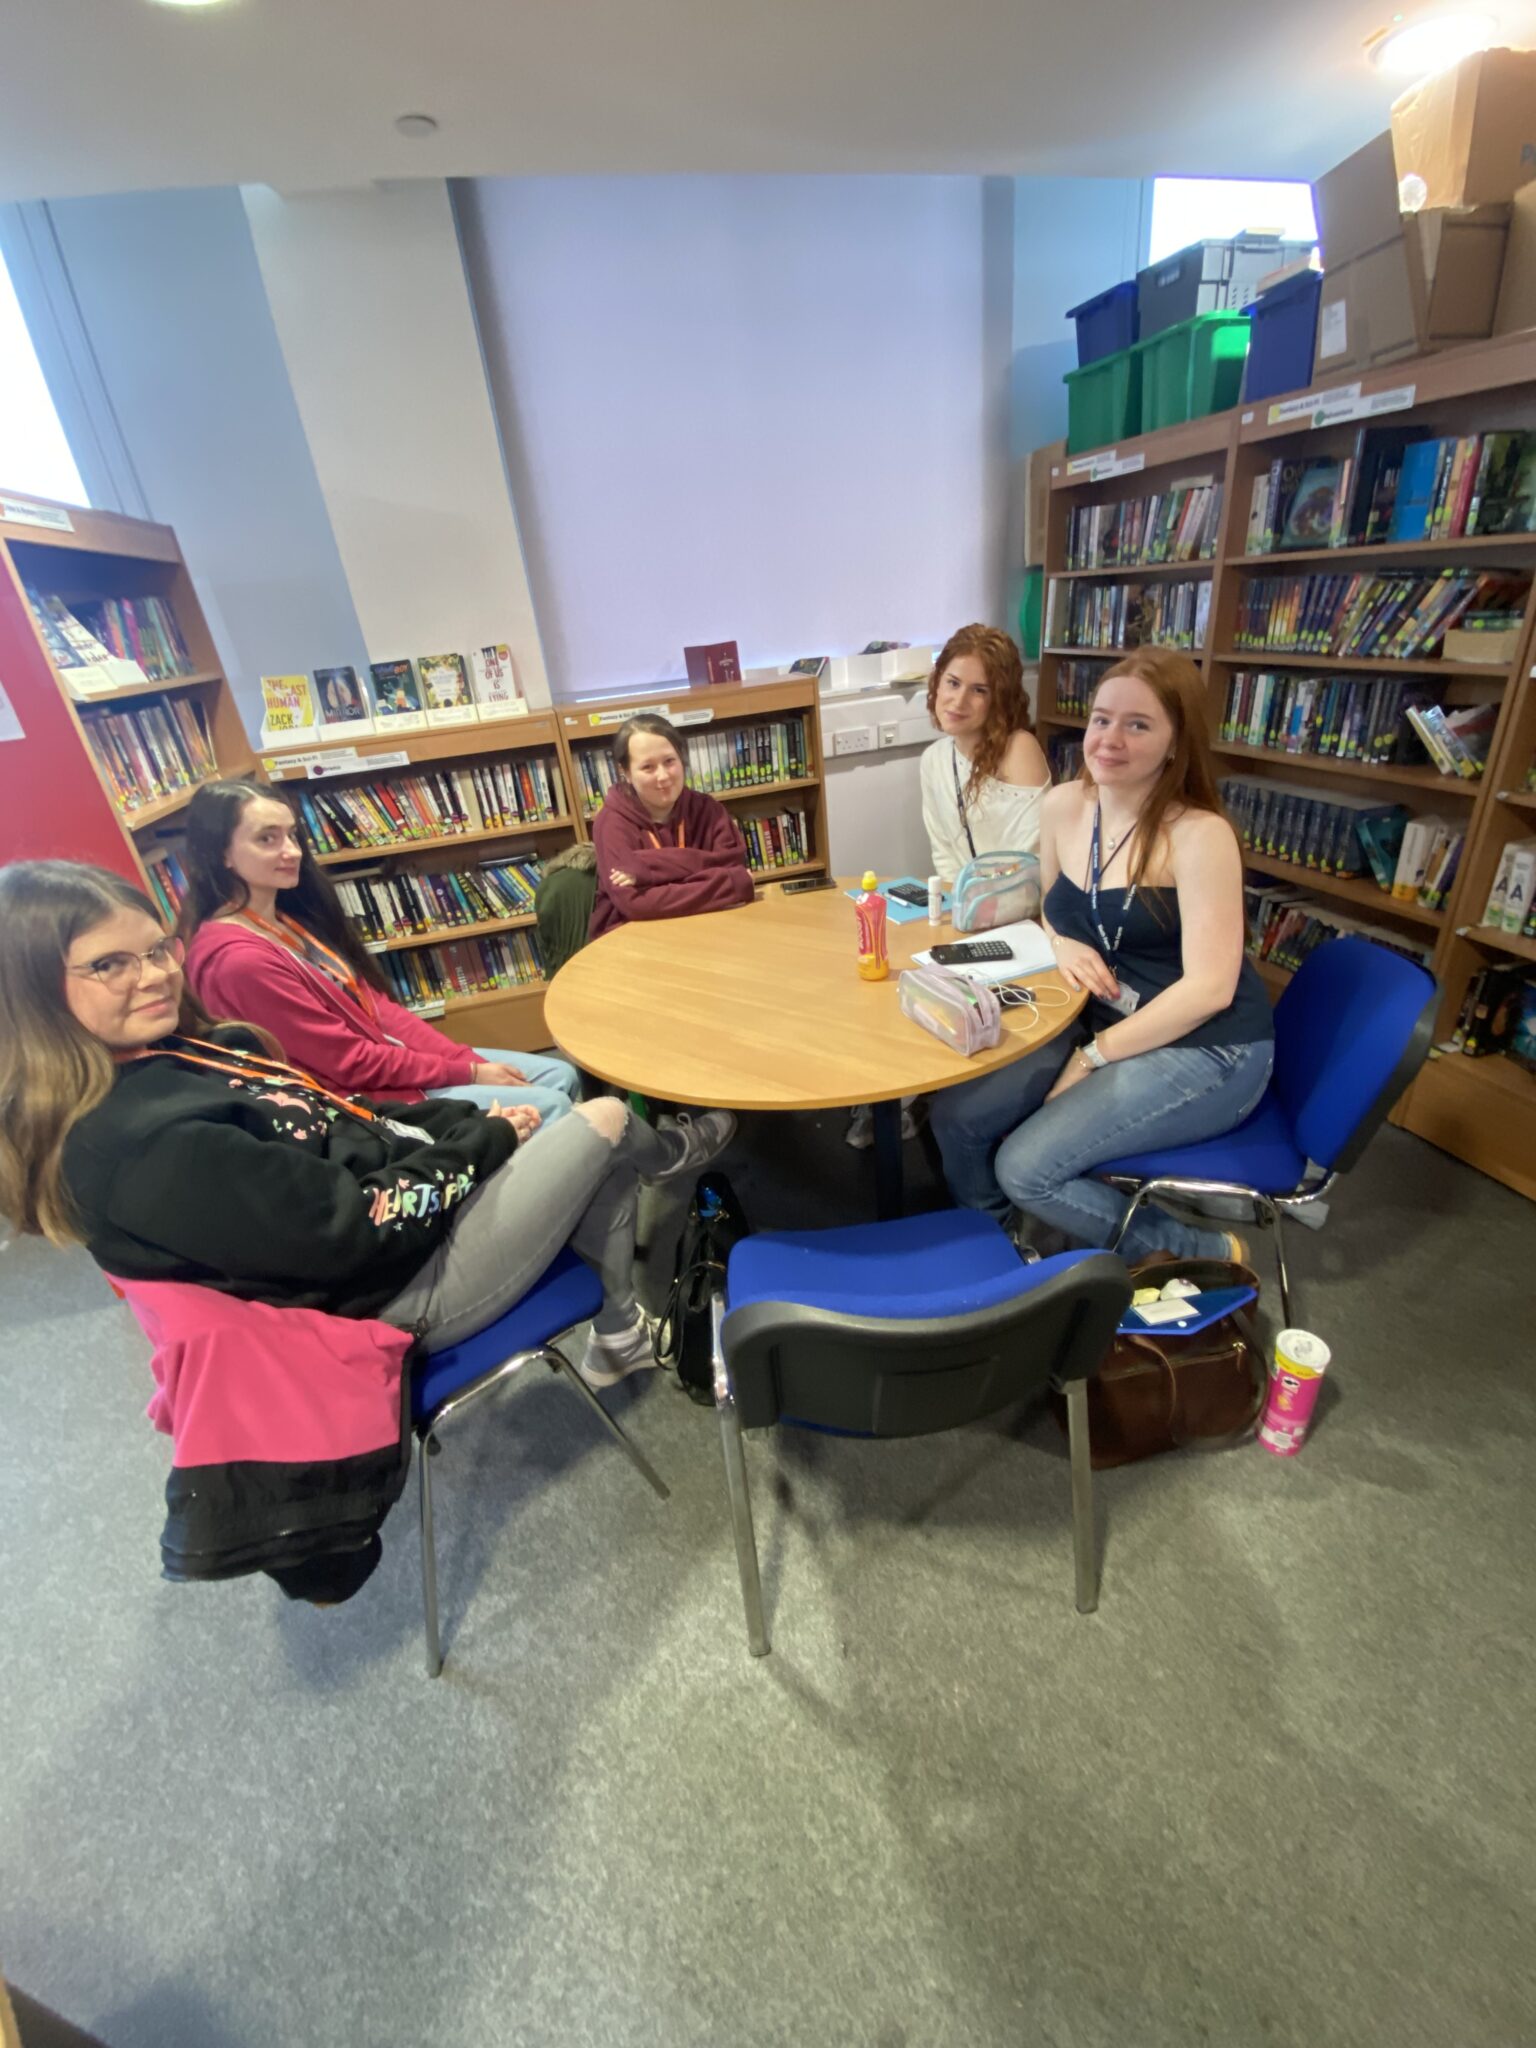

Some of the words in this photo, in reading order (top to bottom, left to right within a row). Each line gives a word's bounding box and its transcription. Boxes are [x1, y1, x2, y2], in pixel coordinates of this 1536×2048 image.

[267, 680, 282, 689] THE
[267, 697, 300, 709] HUMAN
[270, 713, 293, 726] ZACK
[1510, 884, 1523, 902] A
